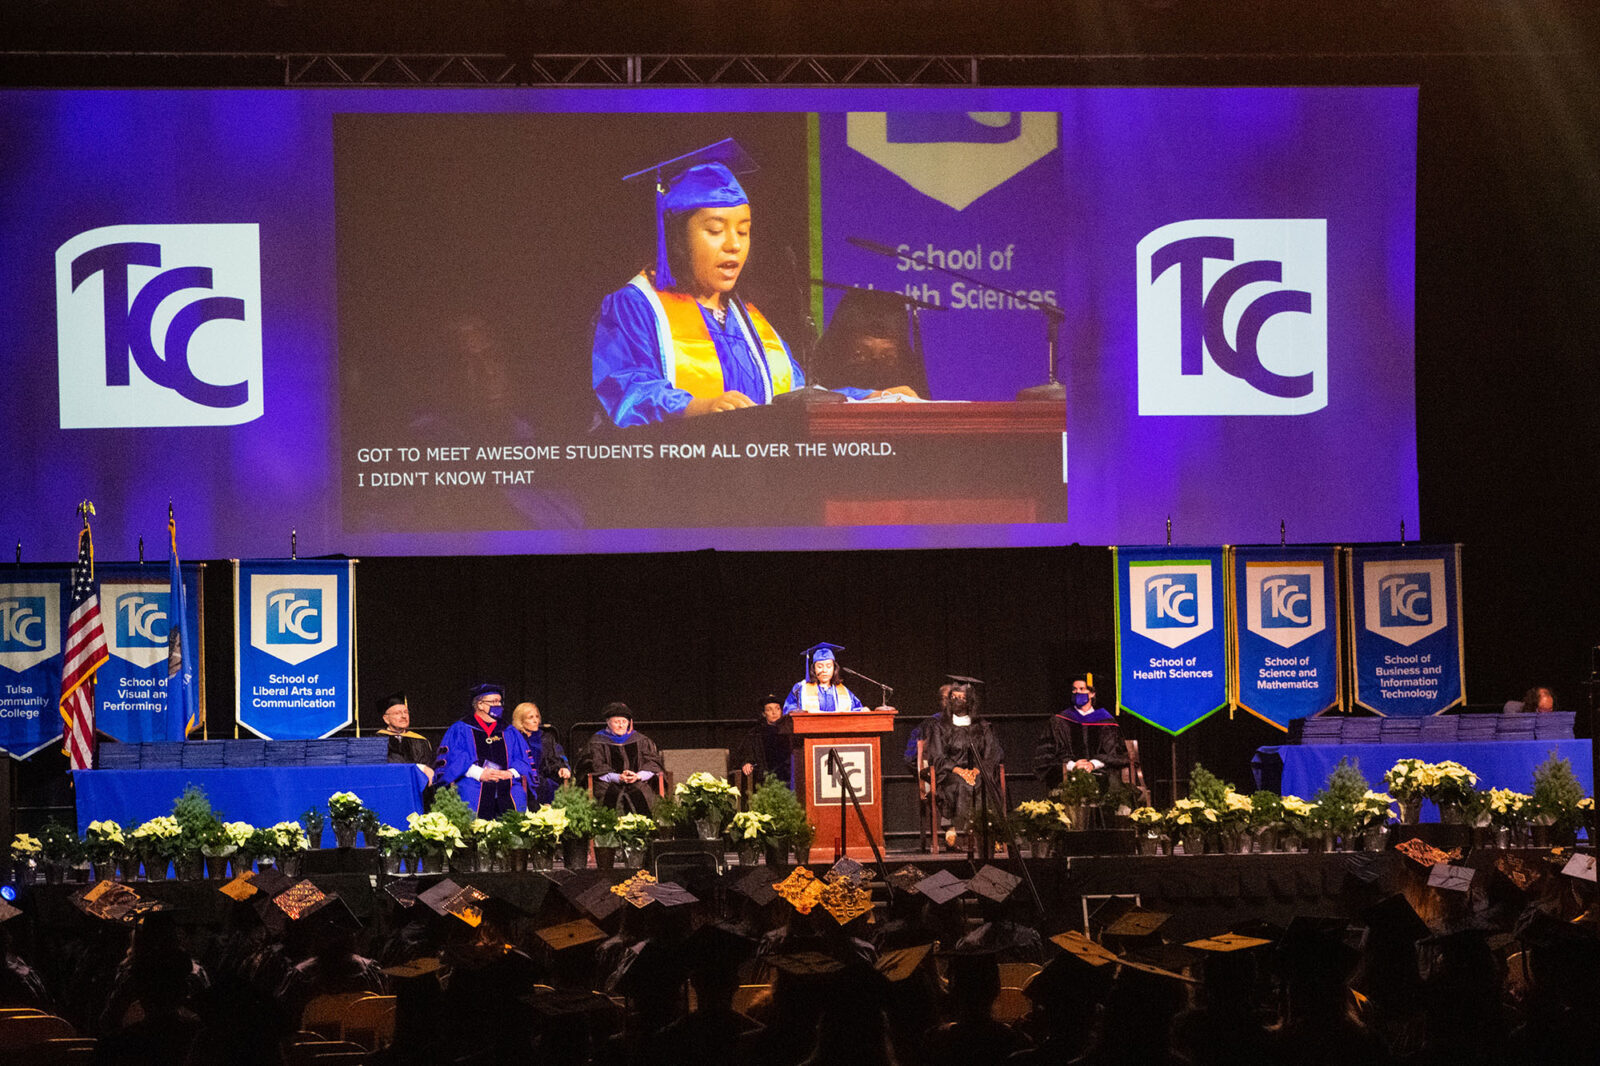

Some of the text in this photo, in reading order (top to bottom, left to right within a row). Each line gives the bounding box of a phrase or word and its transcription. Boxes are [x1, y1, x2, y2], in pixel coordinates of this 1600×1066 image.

[896, 243, 1015, 271] School of
[950, 281, 1058, 310] Sciences
[1151, 236, 1313, 398] TCC
[70, 241, 249, 409] TCC
[357, 442, 897, 462] GOT TO MEET AWESOME STUDENTS FROM ALL OVER THE WORLD.
[358, 470, 535, 487] I DIDN'T KNOW THAT
[1148, 577, 1195, 624] TCC
[1264, 578, 1309, 624] TCC
[1382, 577, 1429, 623] TCC
[119, 596, 168, 644] TCC
[269, 592, 318, 641] TCC
[1149, 656, 1197, 667] School of
[1264, 656, 1310, 666] School of
[1384, 653, 1431, 664] School of
[1133, 668, 1213, 679] Health Sciences
[1258, 667, 1317, 678] Science and
[1375, 664, 1442, 676] Business and
[119, 677, 168, 687] School of
[269, 674, 320, 684] School of
[1257, 679, 1319, 689] Mathematics
[1380, 676, 1438, 687] Information
[5, 685, 33, 694] Tulsa
[117, 689, 168, 699] Visual an
[252, 686, 336, 696] Liberal Arts and
[1380, 688, 1438, 699] Technology
[103, 701, 162, 713] Performing
[252, 698, 336, 708] Communication
[0, 708, 40, 720] College
